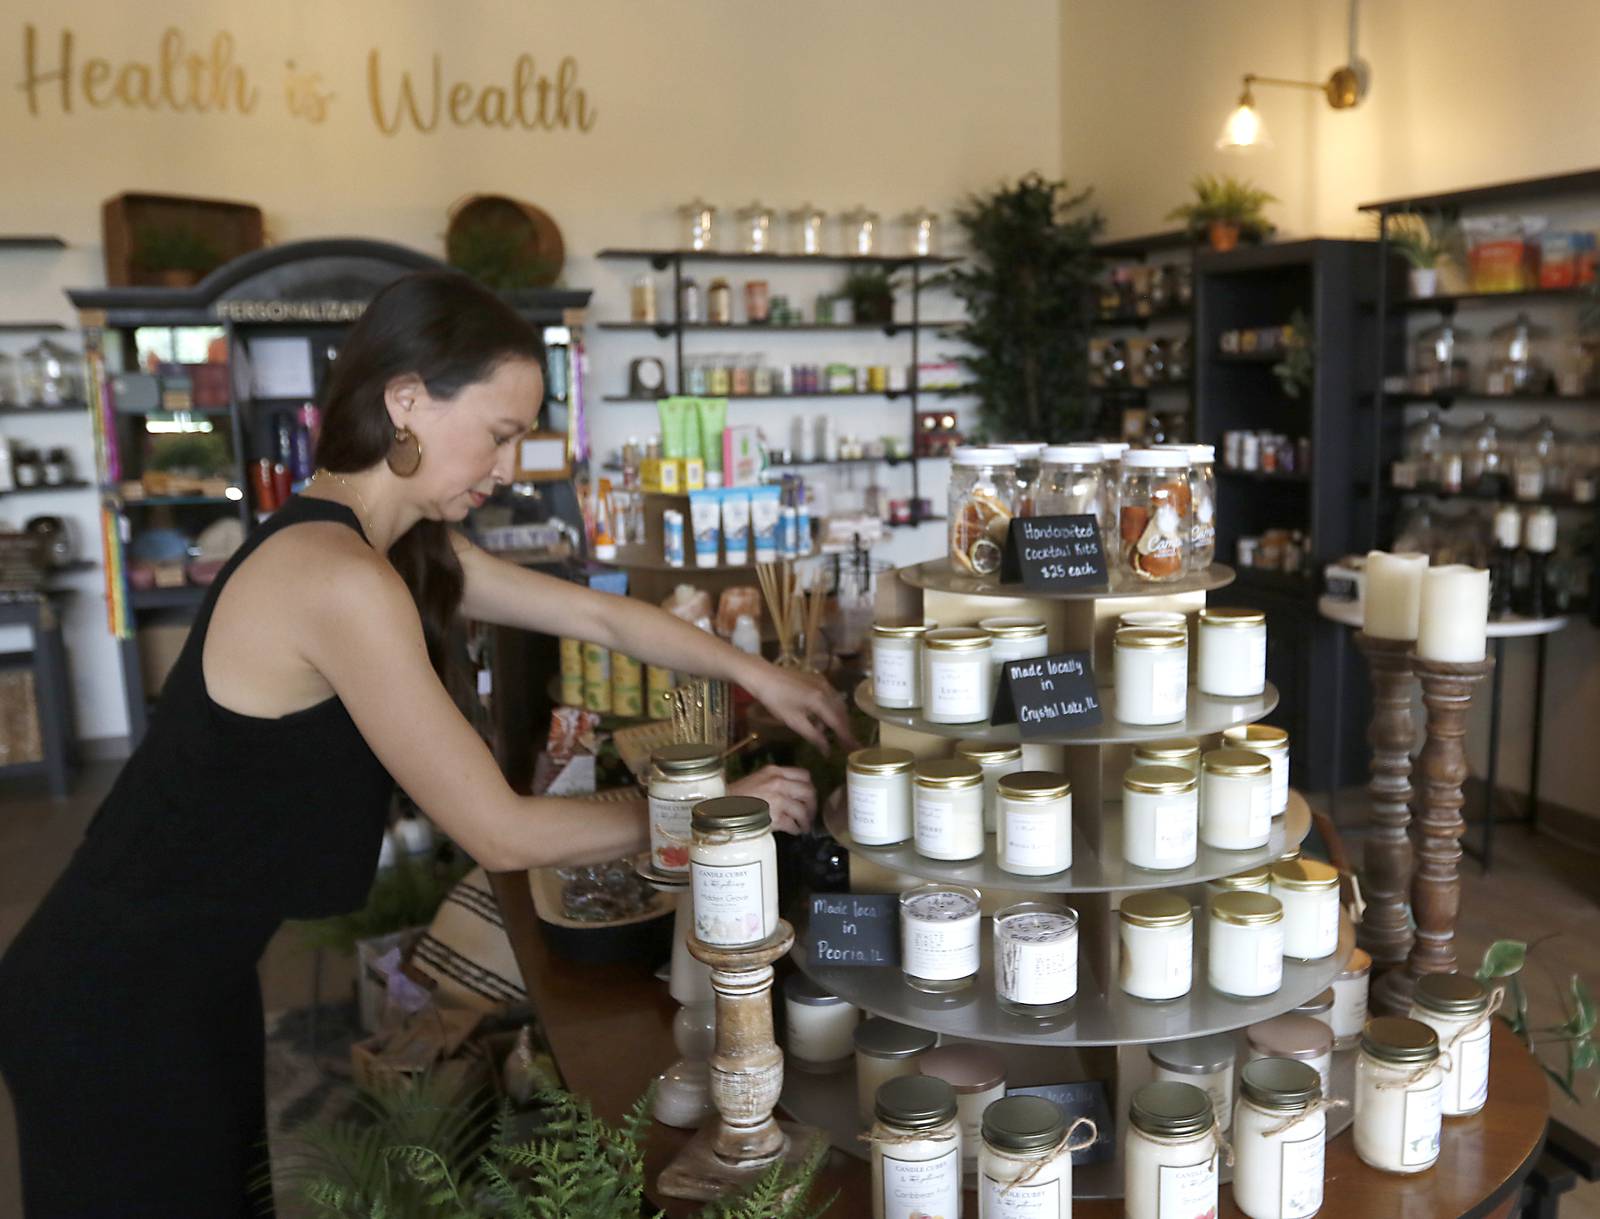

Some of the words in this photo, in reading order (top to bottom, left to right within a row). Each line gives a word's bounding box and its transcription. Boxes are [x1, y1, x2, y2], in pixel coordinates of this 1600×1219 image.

[17, 23, 260, 117] Health
[284, 58, 336, 124] is
[367, 47, 598, 137] Wealth
[1074, 543, 1098, 556] Kits
[1040, 563, 1065, 579] $25
[1068, 562, 1097, 577] each
[1010, 664, 1043, 680] Made
[1047, 659, 1083, 676] locally
[1041, 678, 1055, 691] in
[1021, 704, 1060, 723] Crystal
[814, 899, 848, 915] Made
[842, 920, 857, 935] in
